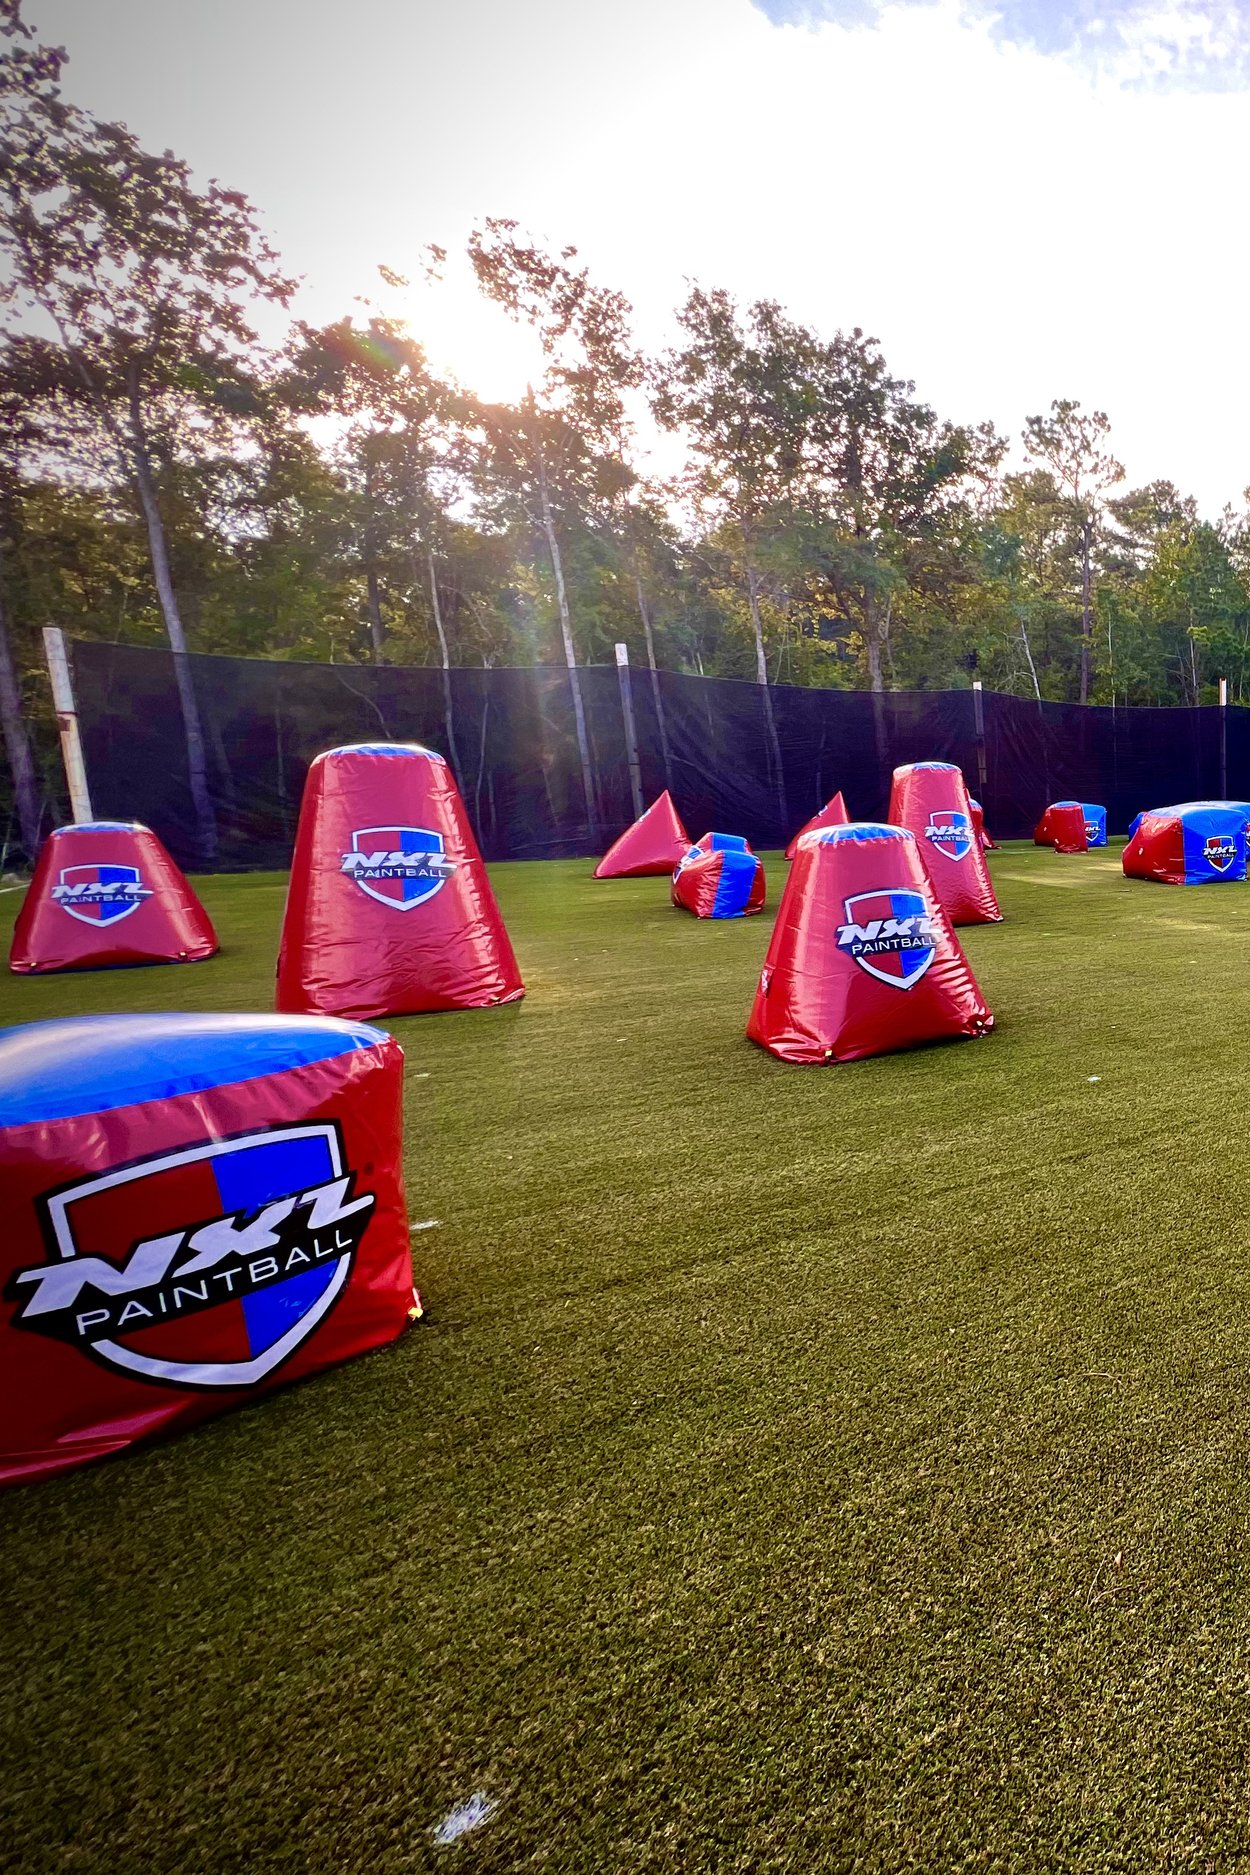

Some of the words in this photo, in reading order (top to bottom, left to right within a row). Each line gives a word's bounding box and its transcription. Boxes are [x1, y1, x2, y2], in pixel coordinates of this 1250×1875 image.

[1203, 845, 1237, 855] NXL
[341, 851, 457, 870] NXL
[354, 868, 447, 878] PAINTBALL
[50, 882, 155, 898] NXL
[60, 895, 142, 904] PAINTBALL
[836, 917, 943, 945] NXL
[851, 936, 936, 955] PAINTBALL
[16, 1177, 375, 1318] NXL
[76, 1230, 353, 1336] PAINTBALL
